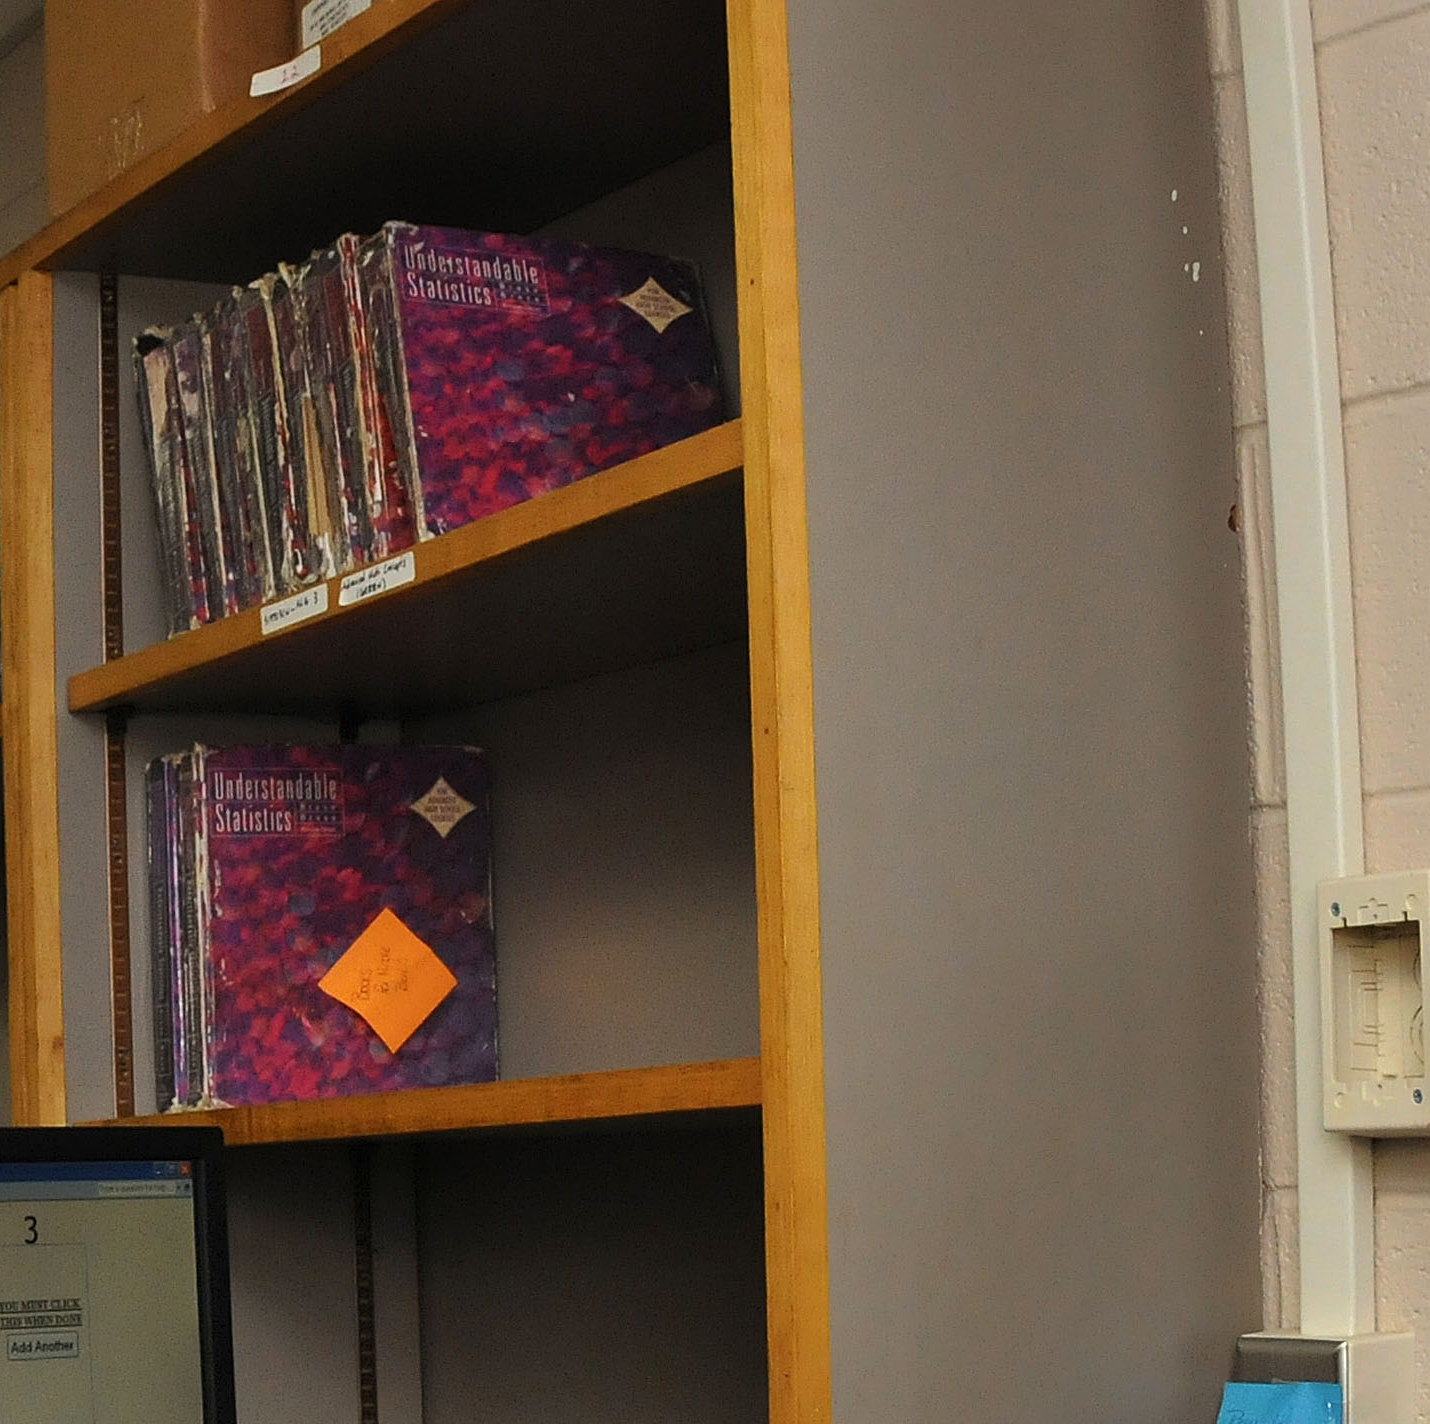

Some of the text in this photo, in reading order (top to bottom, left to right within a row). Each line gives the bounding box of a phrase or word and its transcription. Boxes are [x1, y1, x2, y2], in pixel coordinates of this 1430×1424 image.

[404, 243, 539, 284] Understandable
[407, 271, 492, 306] Statistics
[214, 772, 337, 800] Understandable
[215, 803, 292, 833] Statistics
[24, 1216, 38, 1244] 3
[11, 1340, 74, 1353] Add Another
